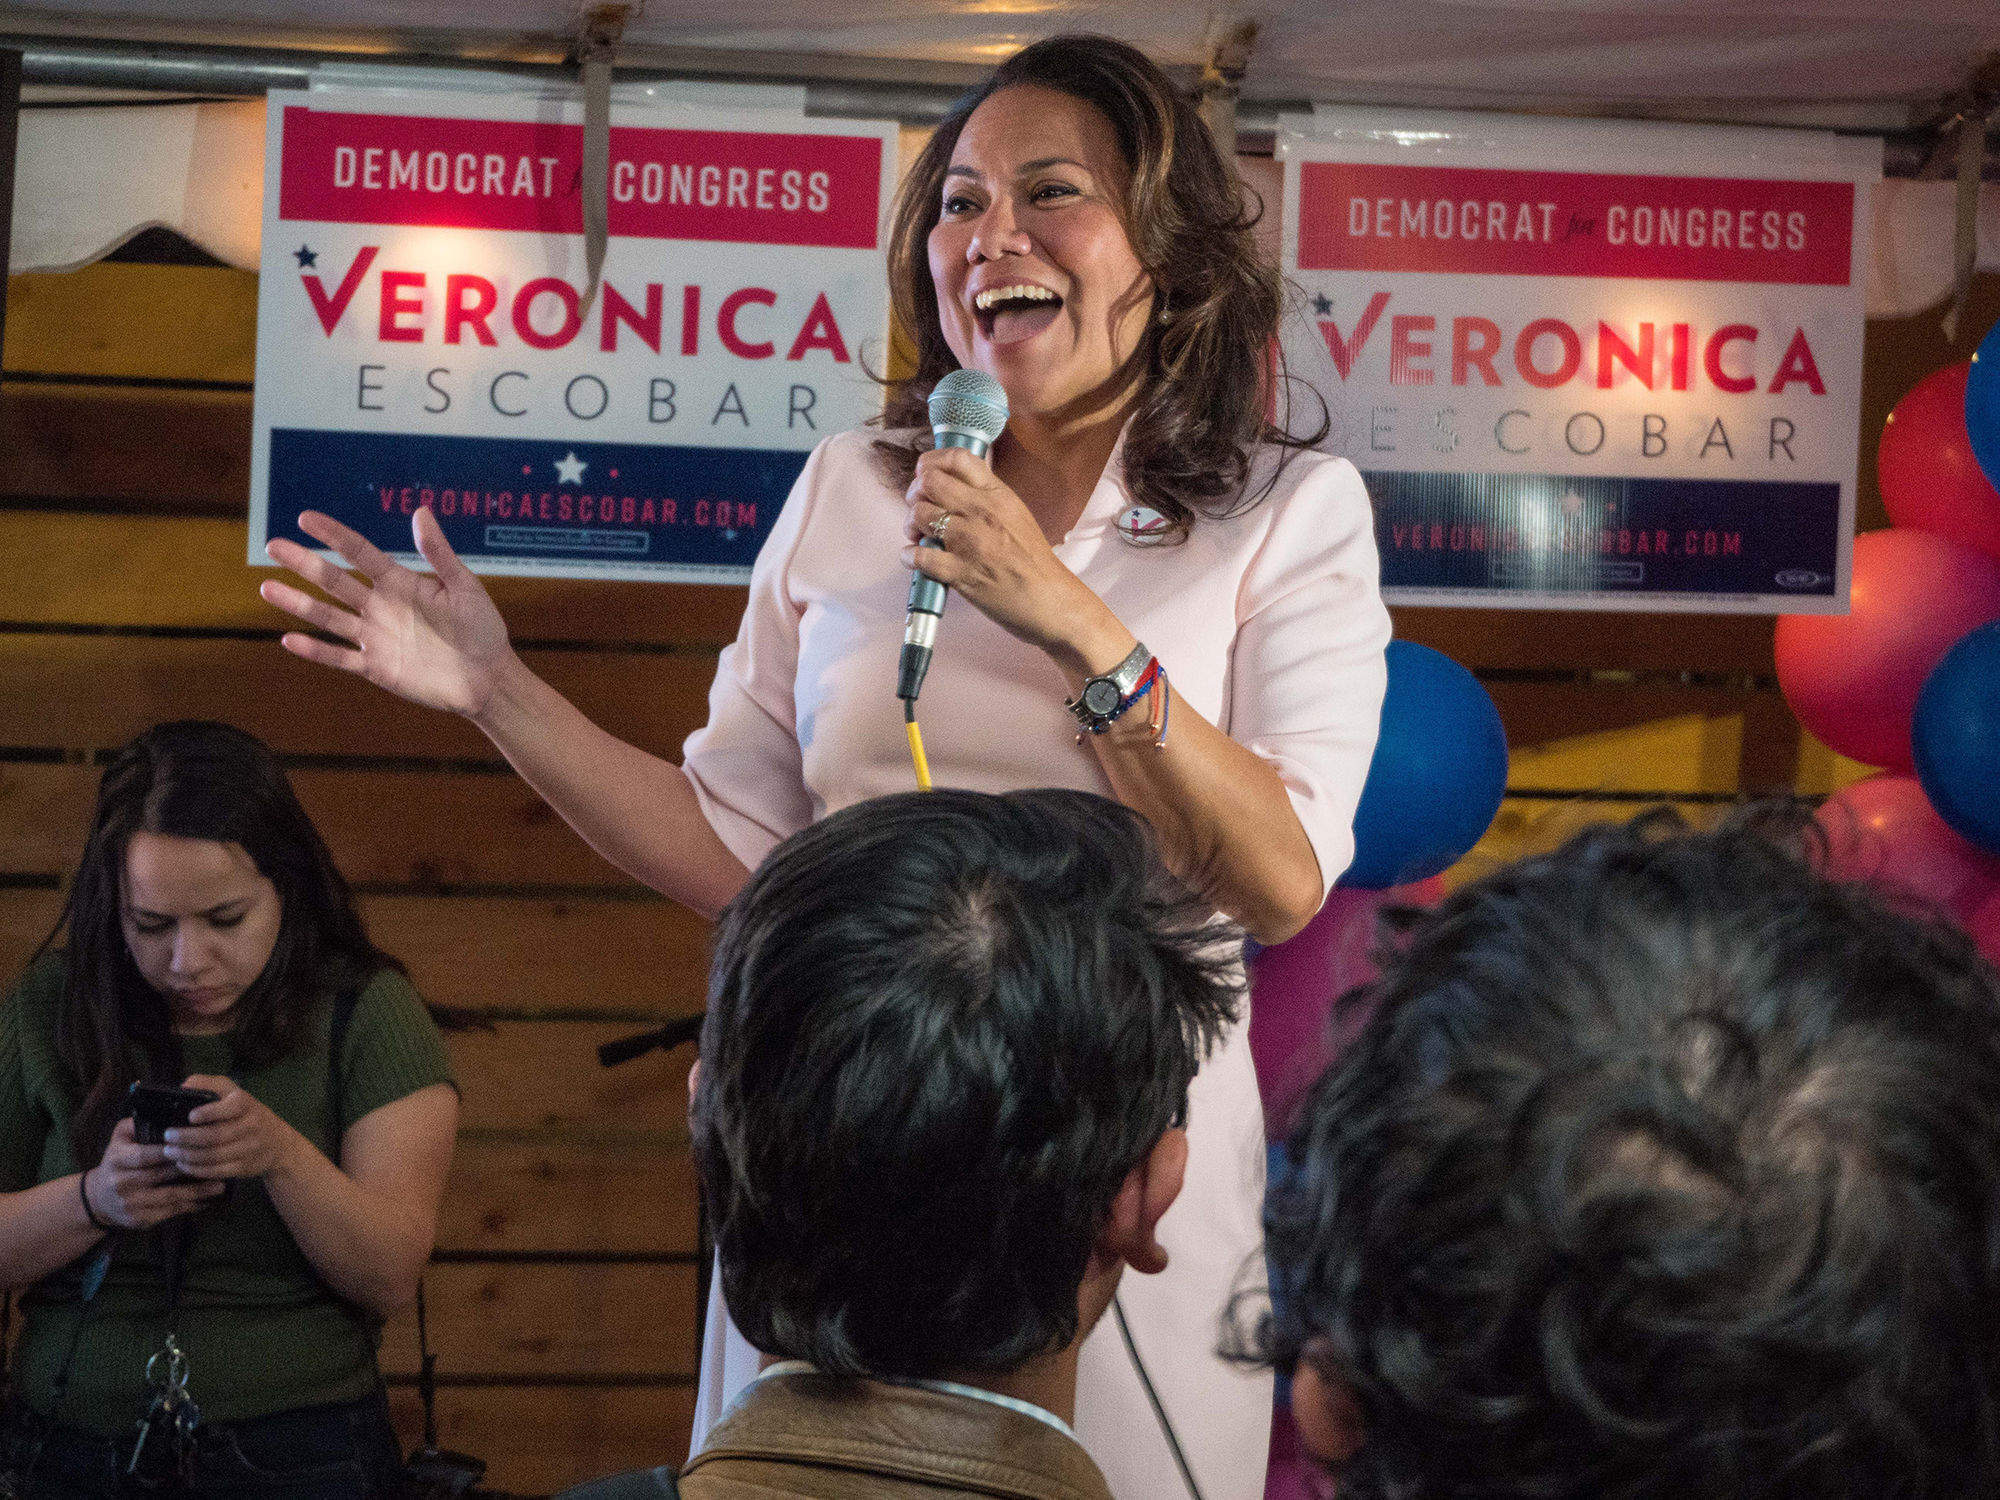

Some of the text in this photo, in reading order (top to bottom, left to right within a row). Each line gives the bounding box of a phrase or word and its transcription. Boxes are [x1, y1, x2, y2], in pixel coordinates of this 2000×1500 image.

[332, 145, 559, 199] DEMOCRAT
[612, 160, 831, 213] CONGRESS
[1348, 197, 1557, 244] DEMOCRAT
[1605, 204, 1807, 251] CONGRESS
[301, 245, 852, 364] VERONICA
[1317, 291, 1827, 396] VERONICA
[356, 364, 818, 431] ESCOBAR
[1370, 404, 1796, 463] ESCOBAR
[379, 486, 757, 529] VERONICAESCOBAR.COM
